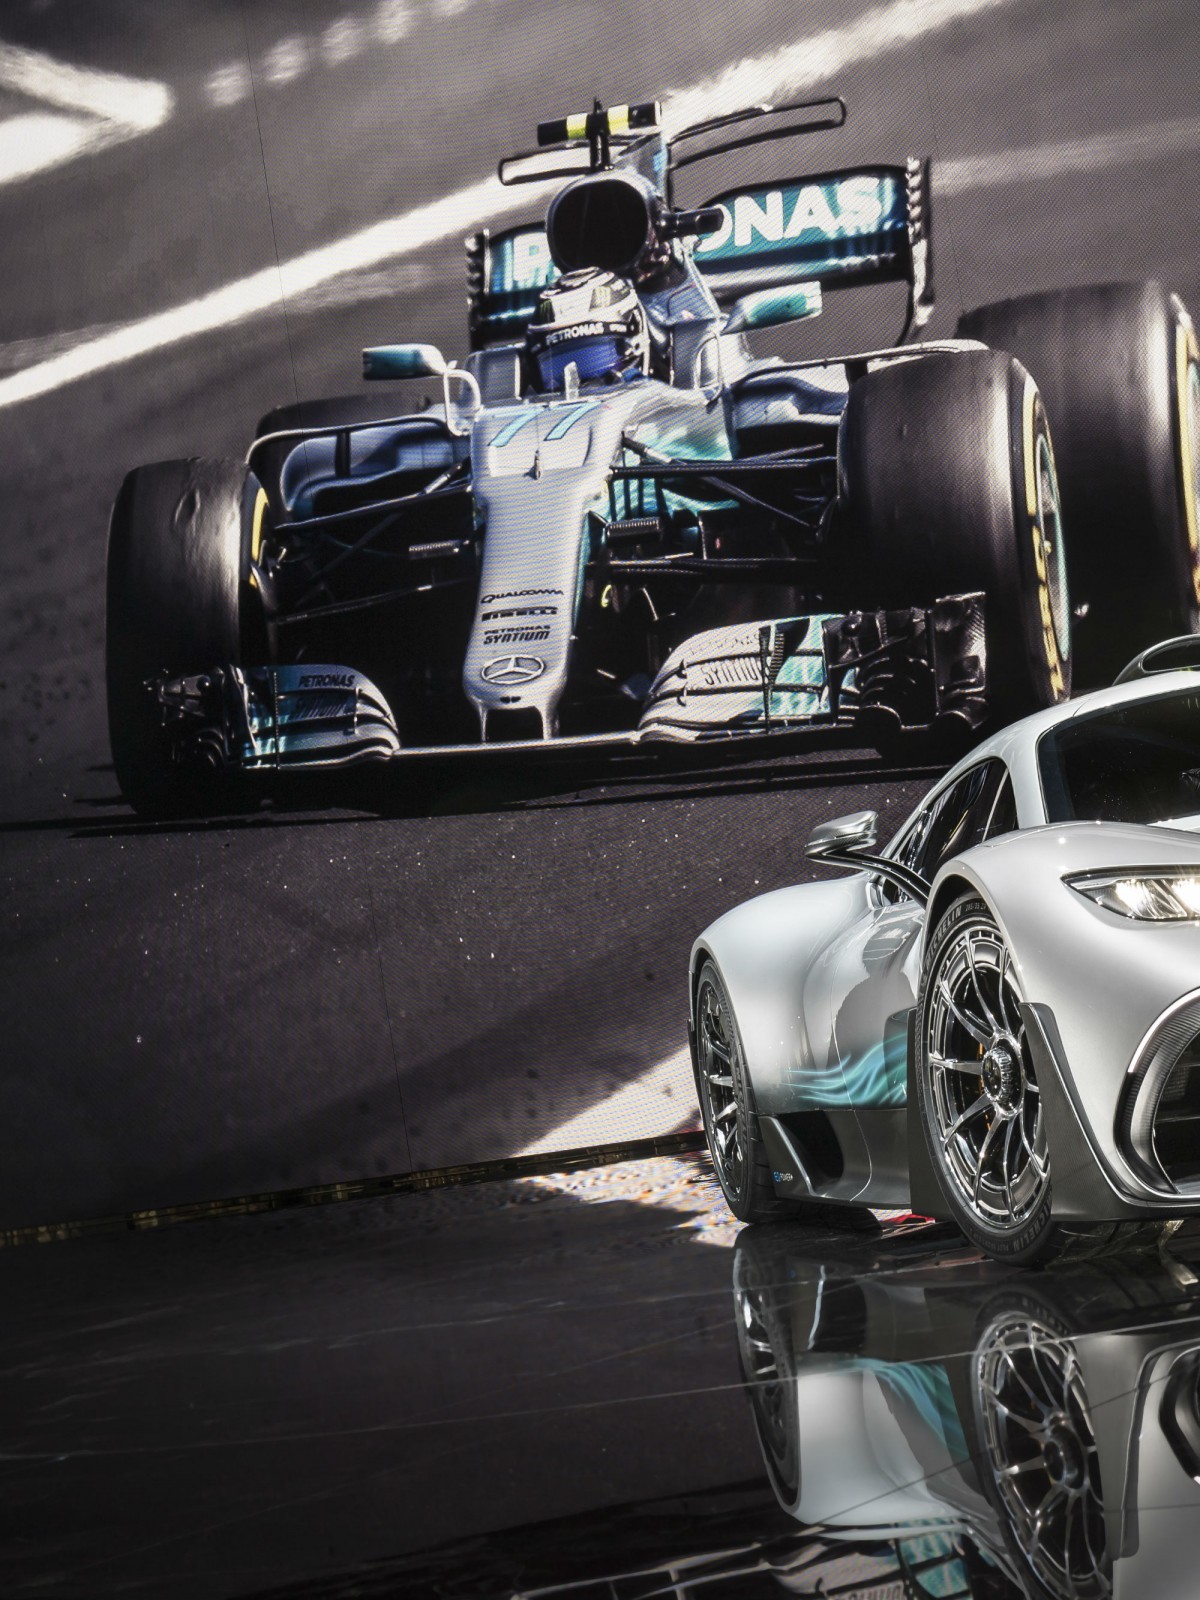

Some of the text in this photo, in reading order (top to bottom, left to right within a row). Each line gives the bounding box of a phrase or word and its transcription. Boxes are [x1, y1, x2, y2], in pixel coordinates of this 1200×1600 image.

[545, 322, 605, 345] PETRONAS
[487, 400, 604, 448] 77
[481, 605, 558, 621] PIRELLI
[484, 625, 551, 635] PETRONAS
[483, 631, 551, 645] SYNTIUM
[299, 674, 356, 688] PETRONAS
